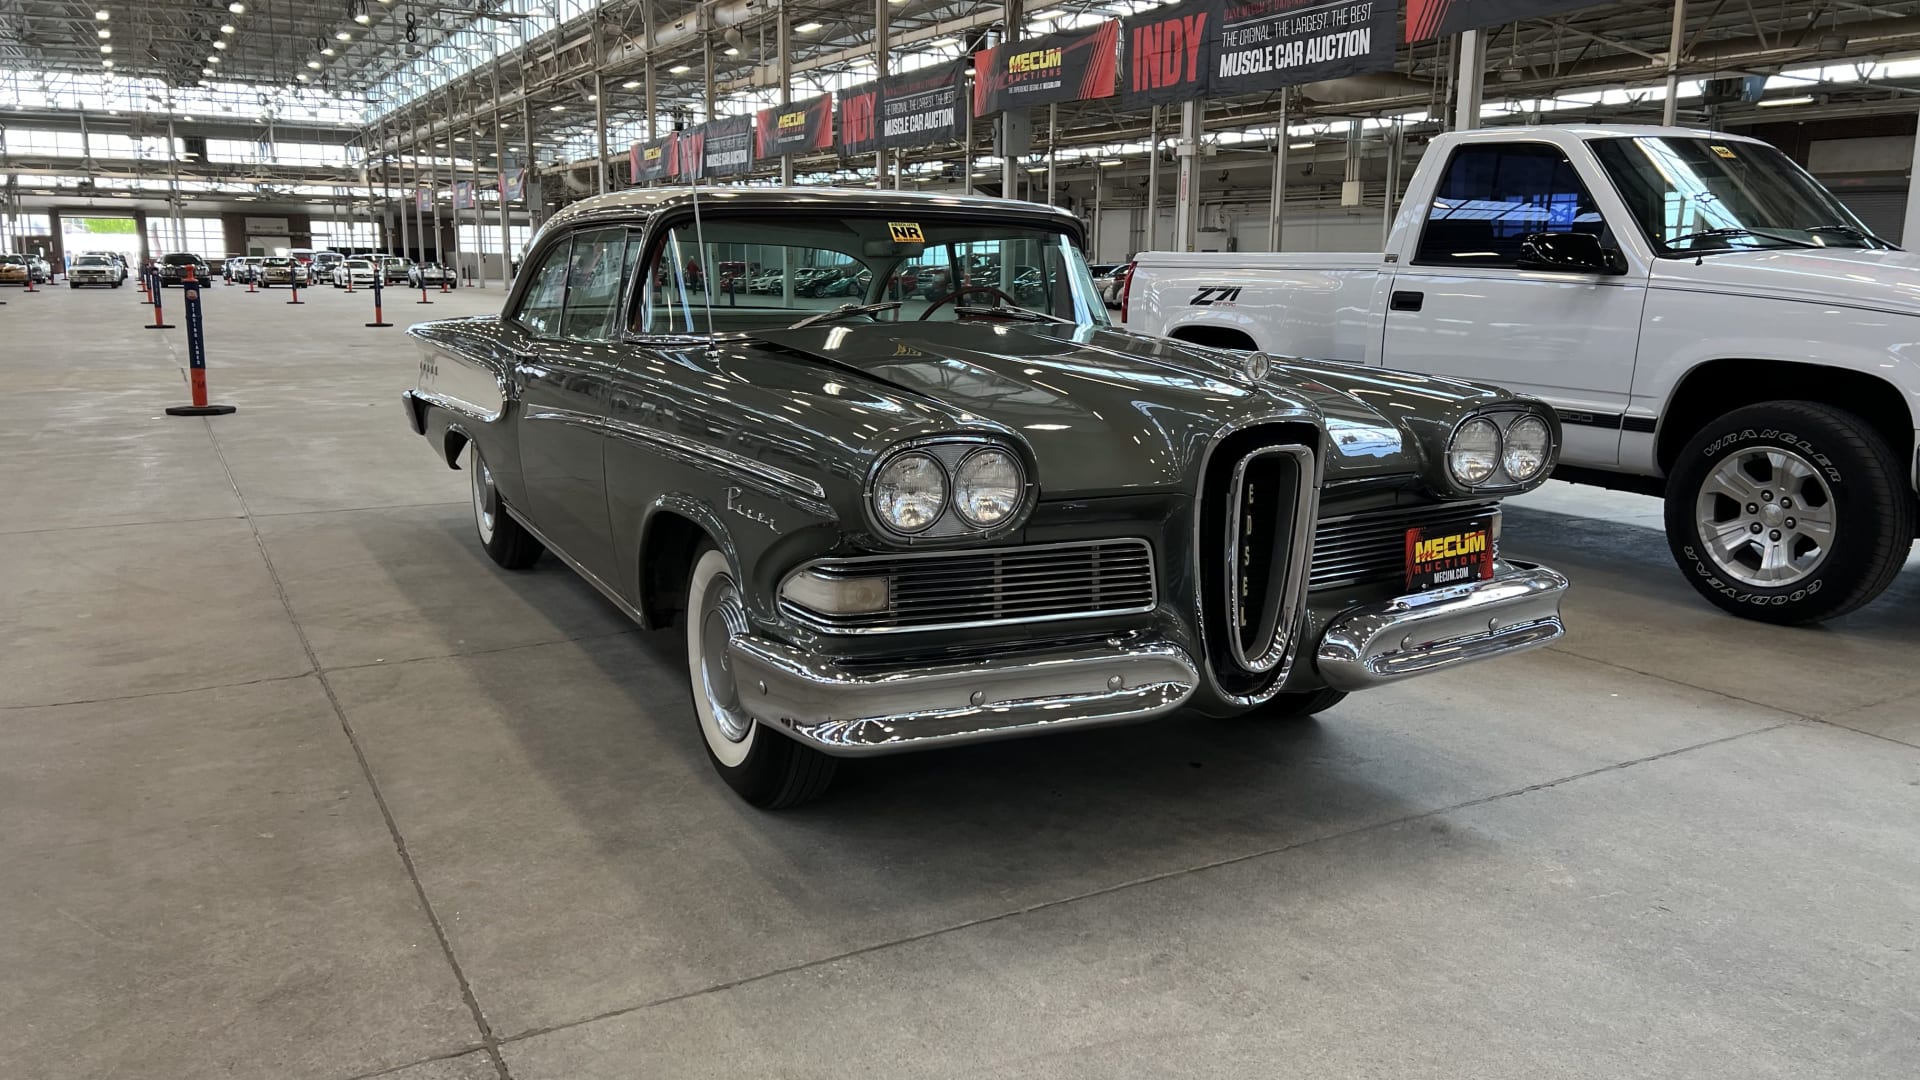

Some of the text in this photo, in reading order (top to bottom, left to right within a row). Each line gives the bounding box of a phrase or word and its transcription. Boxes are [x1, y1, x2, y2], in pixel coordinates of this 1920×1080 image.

[1222, 32, 1238, 48] THE
[1274, 21, 1289, 38] THE
[1291, 12, 1329, 35] LARGEST.
[1332, 9, 1348, 27] THE
[1350, 2, 1373, 23] BEST
[1008, 47, 1061, 74] MECUM
[1133, 12, 1208, 92] INDY
[1219, 27, 1371, 78] MUSCLE CAR AUCTION
[842, 91, 877, 145] INDY
[884, 107, 955, 137] MUSCLE CAR AUCTION
[892, 226, 921, 239] NR
[1189, 286, 1243, 306] Z71
[1704, 429, 1842, 483] WRANGLER
[1239, 483, 1255, 628] EDSEL
[1414, 553, 1488, 575] AUCTIONS
[1415, 530, 1486, 564] MECUM
[1433, 567, 1469, 584] MECUM.COM
[1683, 545, 1823, 605] GOODYEAR
